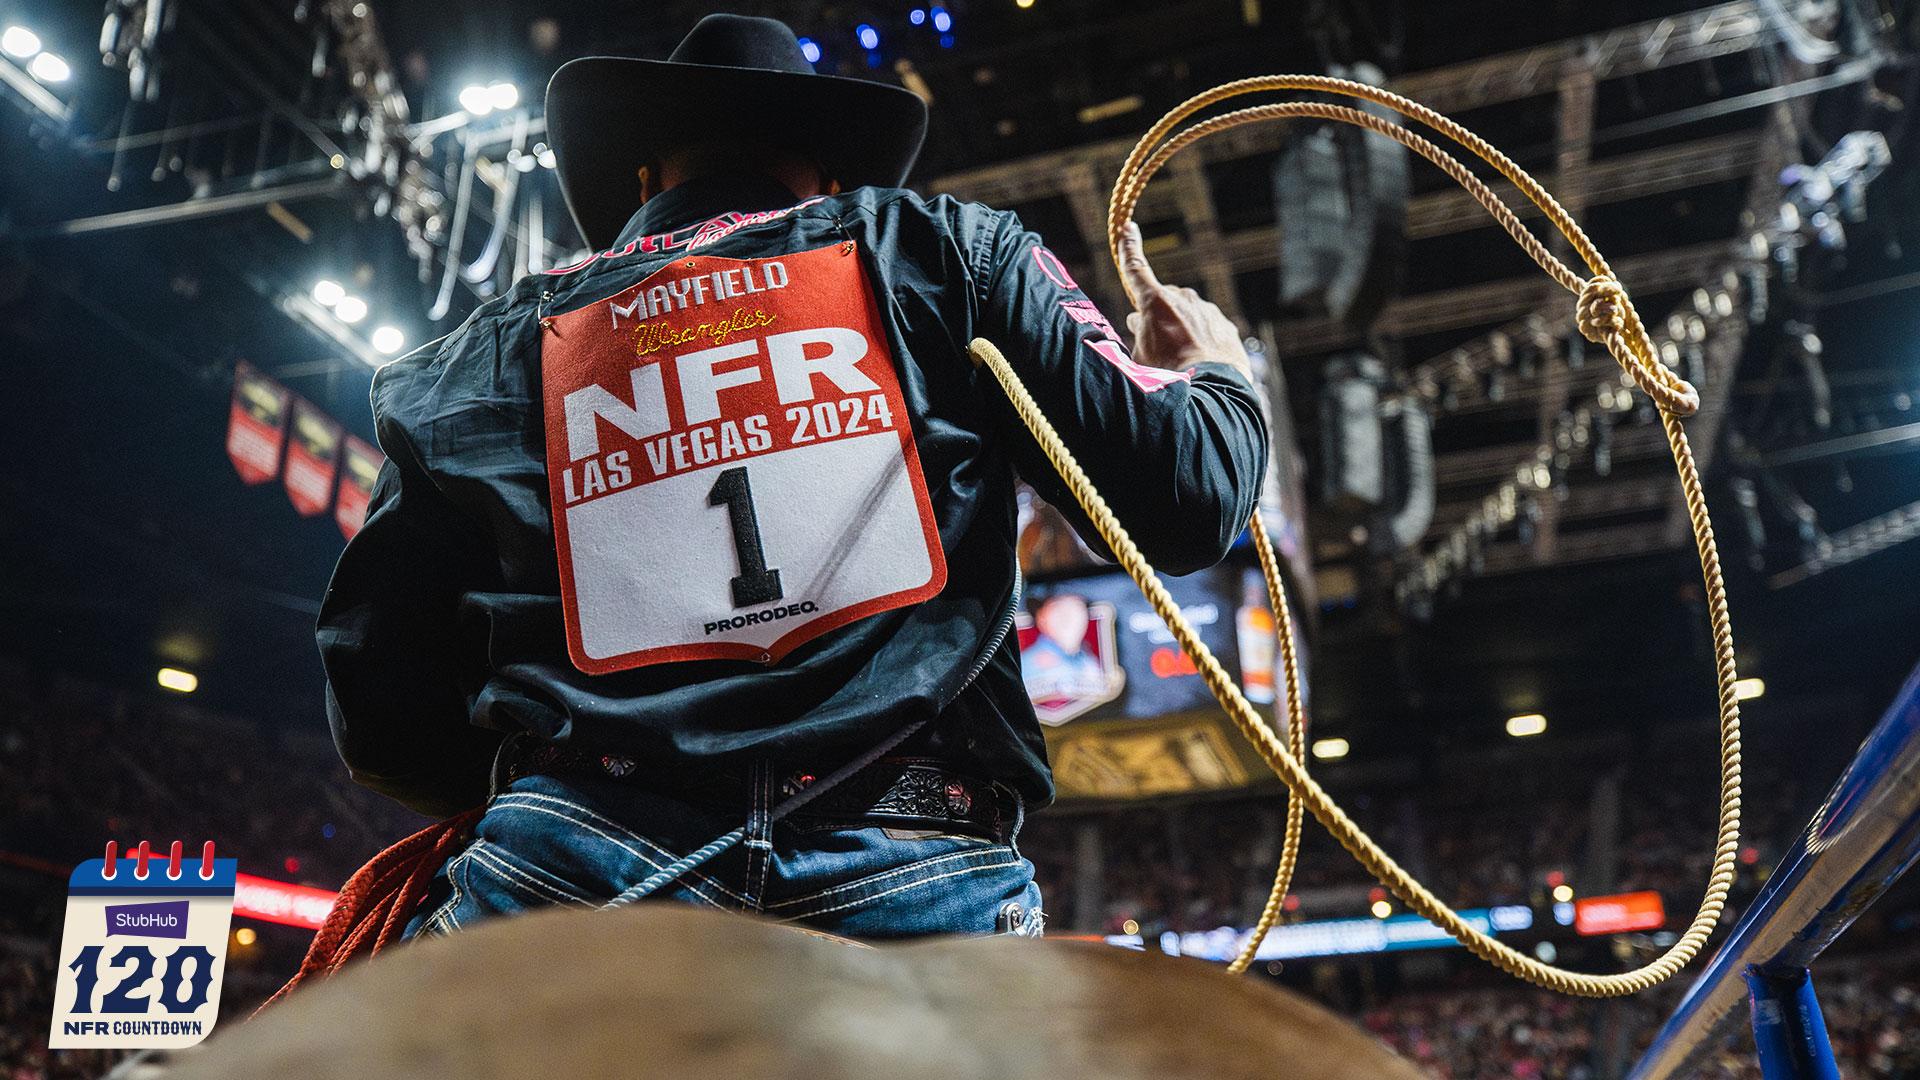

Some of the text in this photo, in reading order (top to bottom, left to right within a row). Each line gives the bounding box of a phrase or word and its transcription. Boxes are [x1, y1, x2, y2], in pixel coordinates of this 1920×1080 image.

[610, 261, 788, 329] MAYFIELD
[631, 307, 776, 356] Wrangler
[562, 395, 894, 504] LAS VEGAS 2024
[564, 328, 882, 462] NFR
[708, 466, 783, 607] 1
